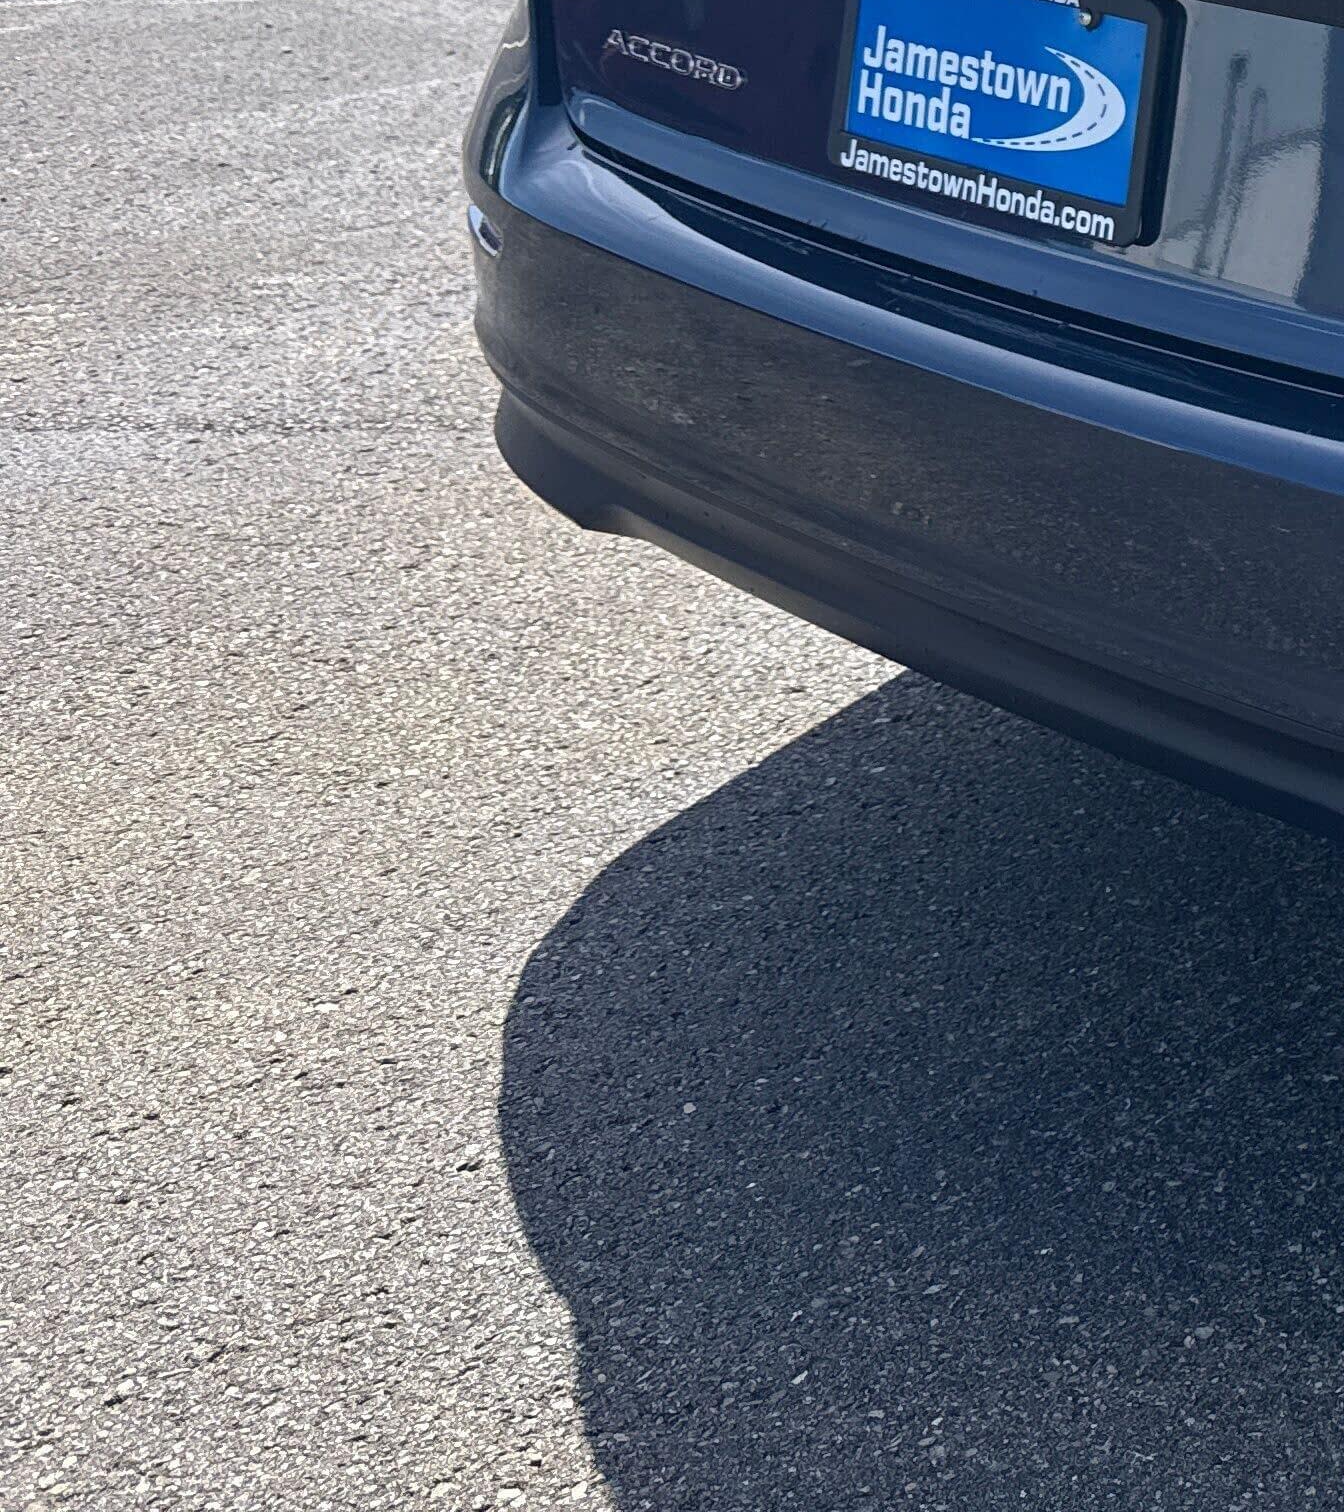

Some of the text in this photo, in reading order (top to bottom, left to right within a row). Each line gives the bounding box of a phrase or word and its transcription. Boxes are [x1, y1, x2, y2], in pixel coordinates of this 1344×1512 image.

[602, 29, 742, 90] ACCORD
[863, 25, 1071, 113] Jamestown
[857, 70, 972, 139] Honda
[840, 139, 1115, 240] JamestownHonda.com
